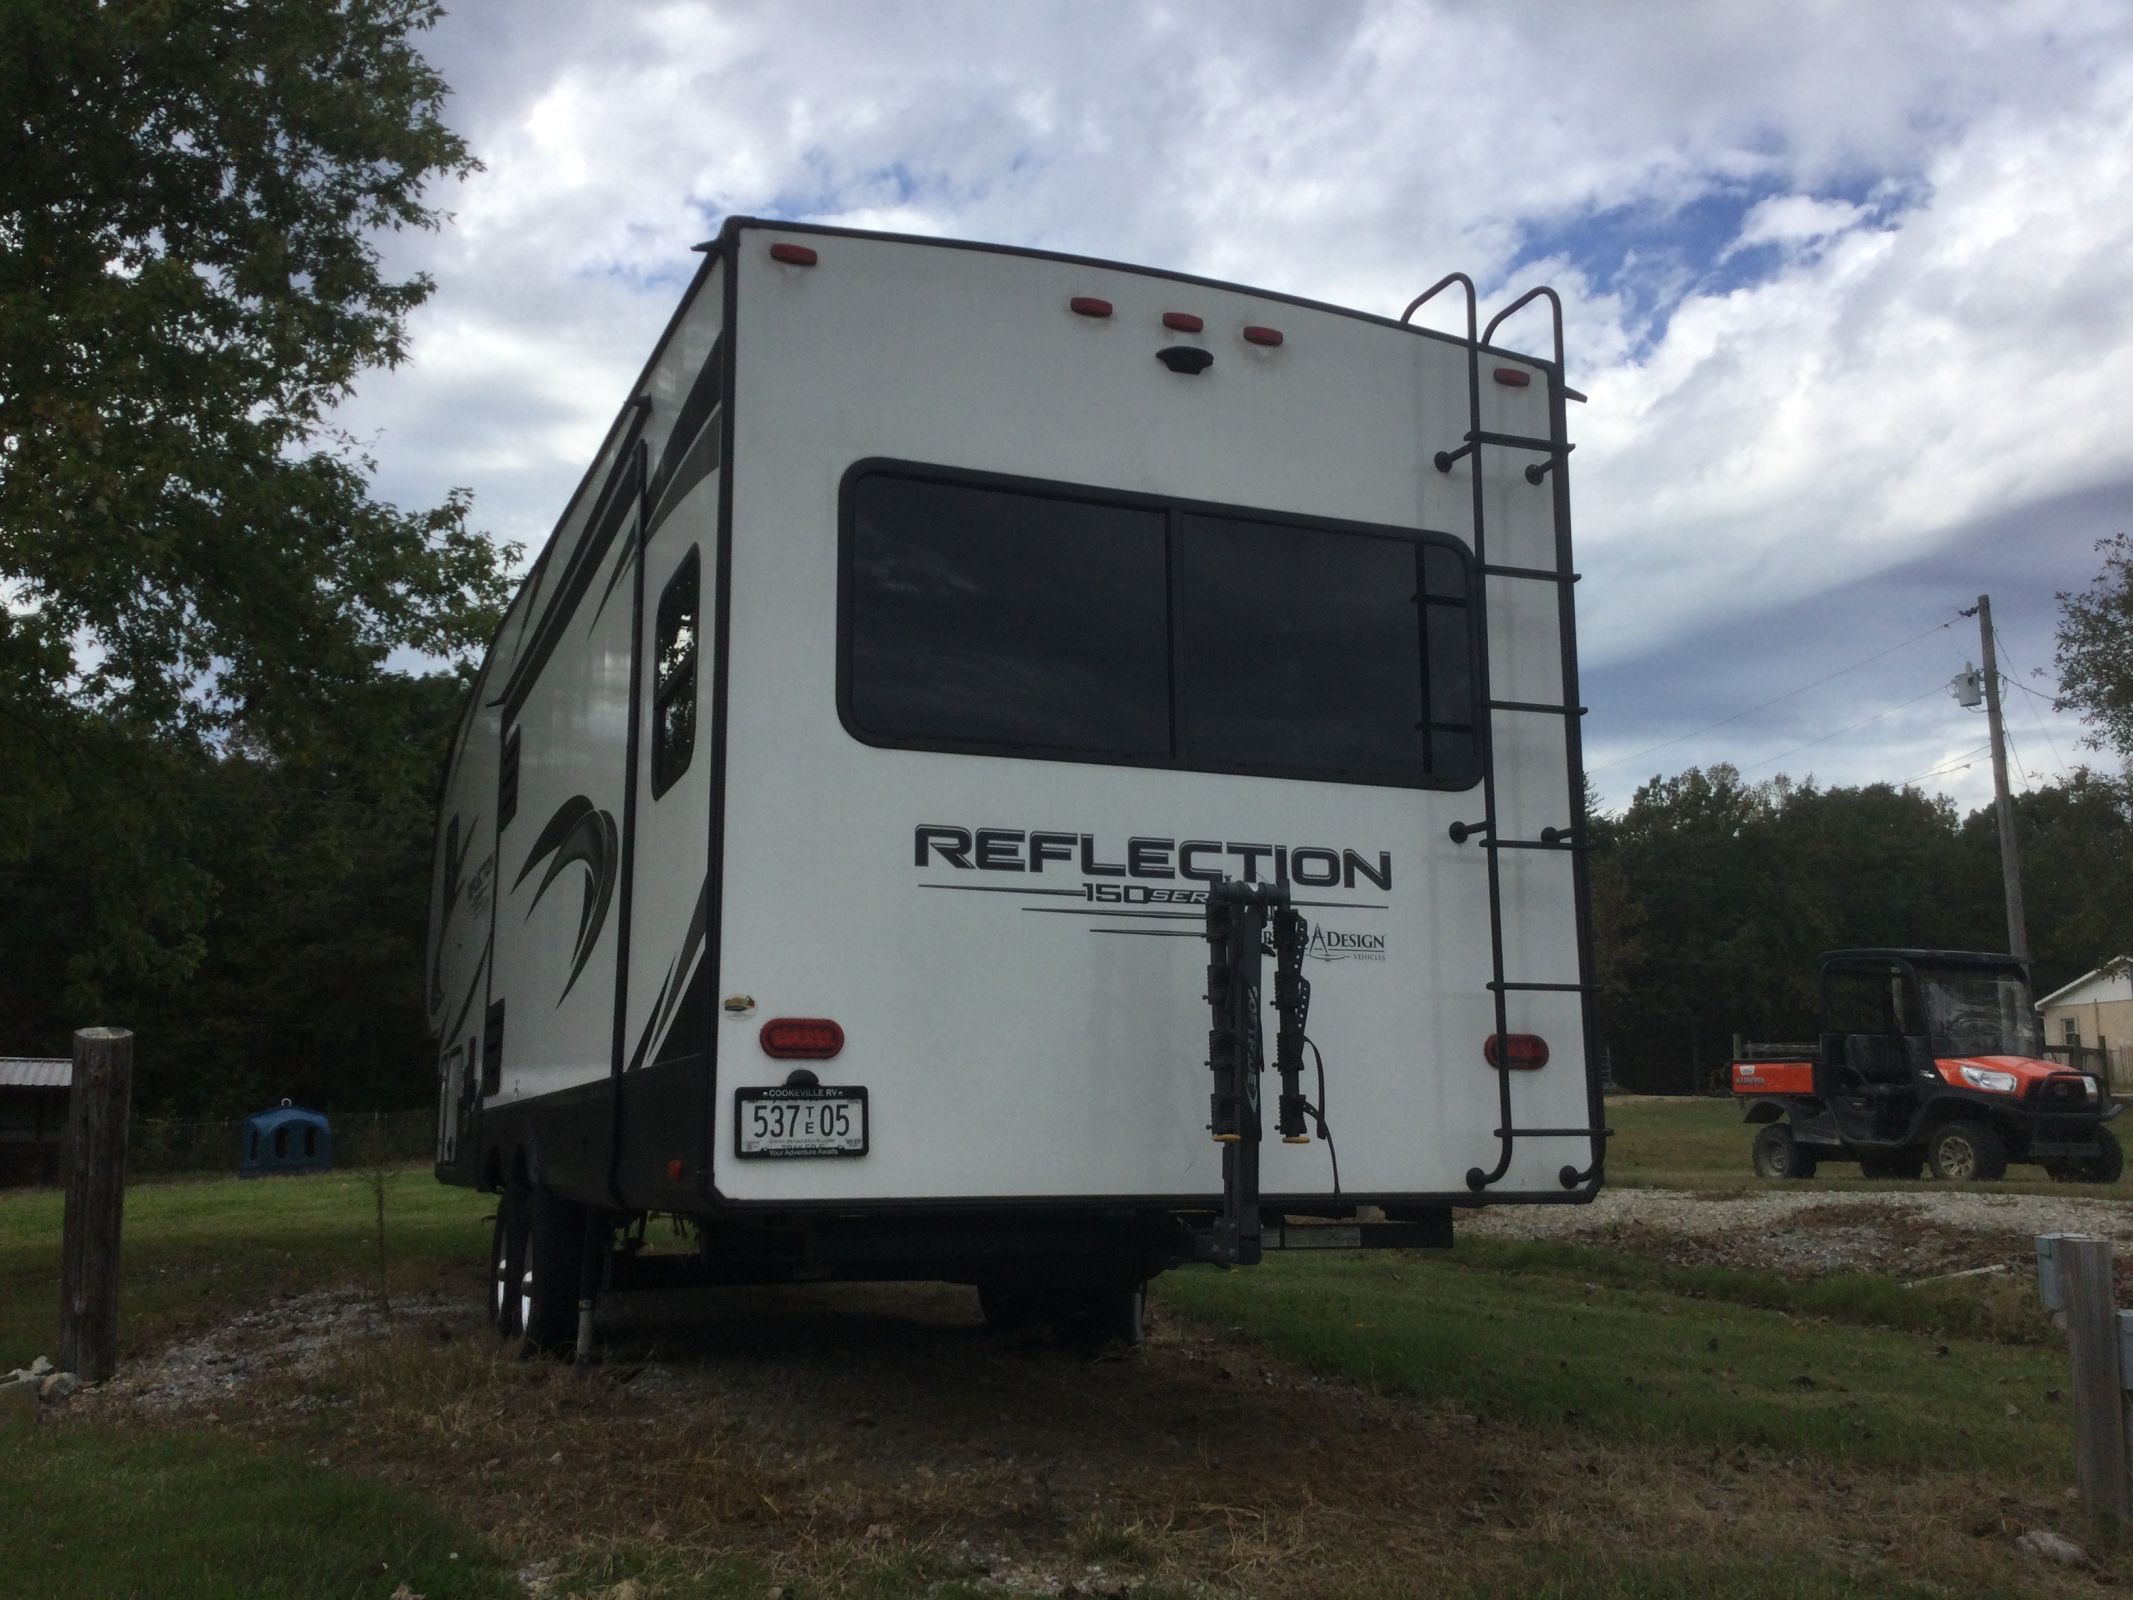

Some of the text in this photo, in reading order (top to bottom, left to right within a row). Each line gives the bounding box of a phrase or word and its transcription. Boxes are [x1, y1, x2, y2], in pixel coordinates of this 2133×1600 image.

[914, 824, 1392, 891] REFLECTION
[1082, 882, 1210, 904] 150 SER
[1327, 931, 1385, 948] DESIGN
[769, 1089, 838, 1097] COOKEVILLE RV
[754, 1104, 800, 1138] 537
[820, 1104, 850, 1137] 05
[784, 1148, 817, 1156] Adventure
